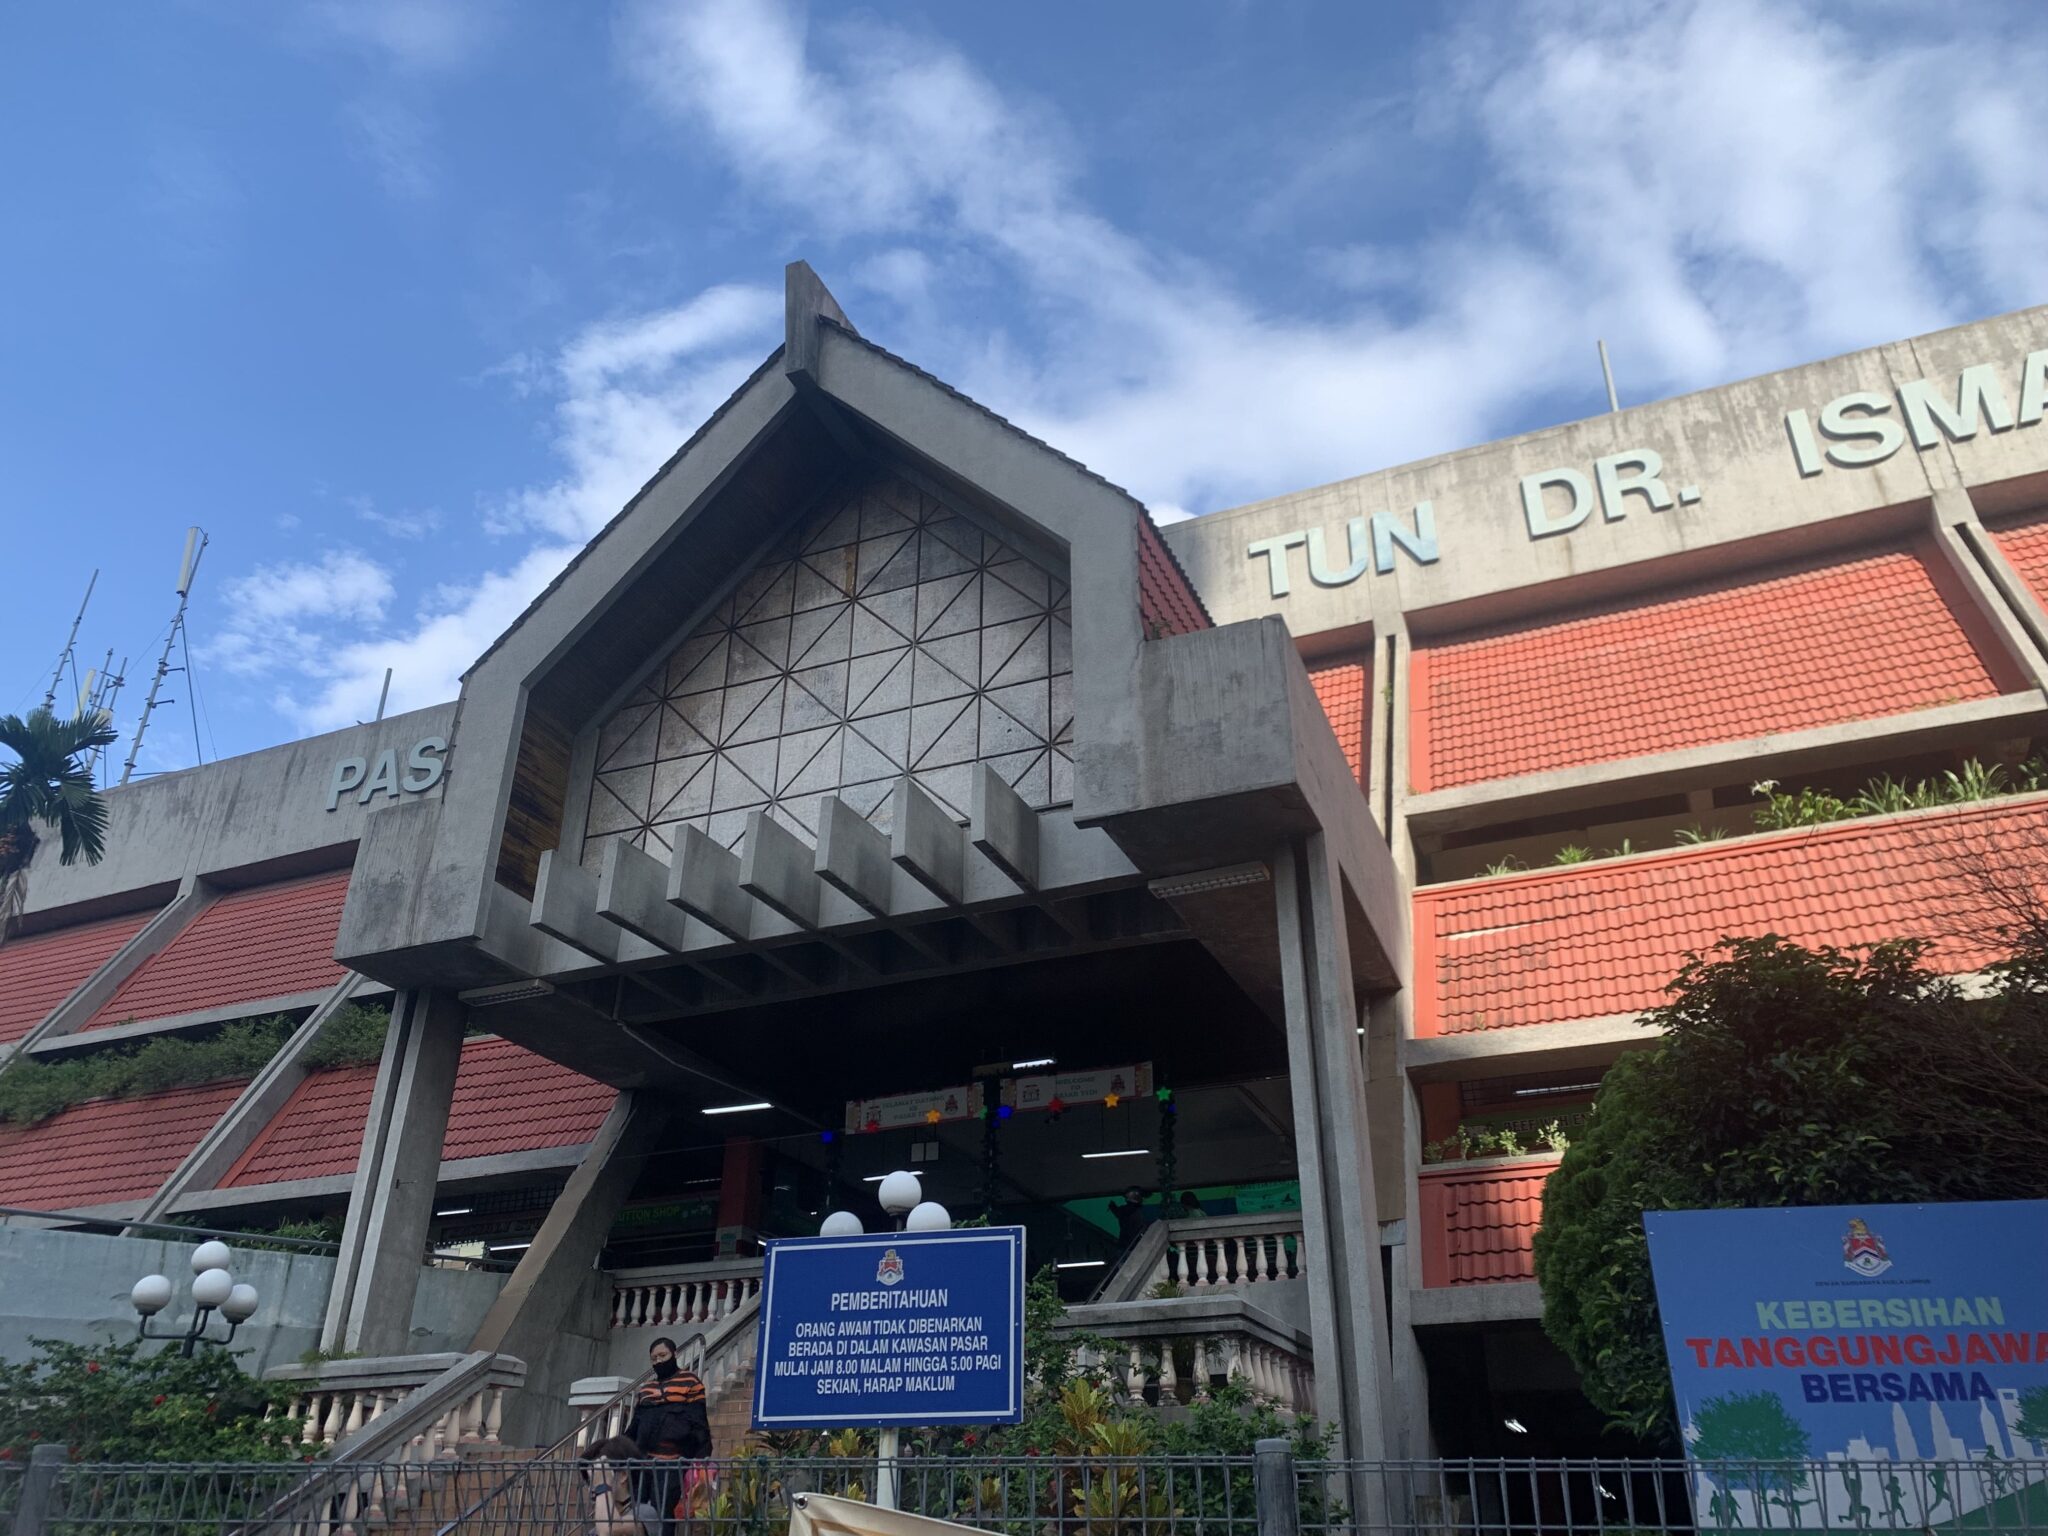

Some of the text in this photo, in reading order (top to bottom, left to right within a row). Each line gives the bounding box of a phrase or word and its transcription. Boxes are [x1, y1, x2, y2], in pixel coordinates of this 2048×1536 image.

[1247, 500, 1440, 598] TUN
[1519, 449, 1703, 541] DR.
[831, 1289, 948, 1311] PEMBERITAHUAN
[1755, 1297, 2005, 1330] KEBERSIHAN
[796, 1317, 982, 1338] ORANG AWAM TIDAK DIBENARKAN
[788, 1336, 988, 1357] BERADA DI DALAM KAWASAN PASAR
[774, 1354, 1001, 1376] MULAI JAM 8.00 MALAM HINGGA 5.00 PAGI
[817, 1375, 955, 1396] SEKIAN, HARAP MAKLUM
[1800, 1371, 1997, 1403] BERSAMA
